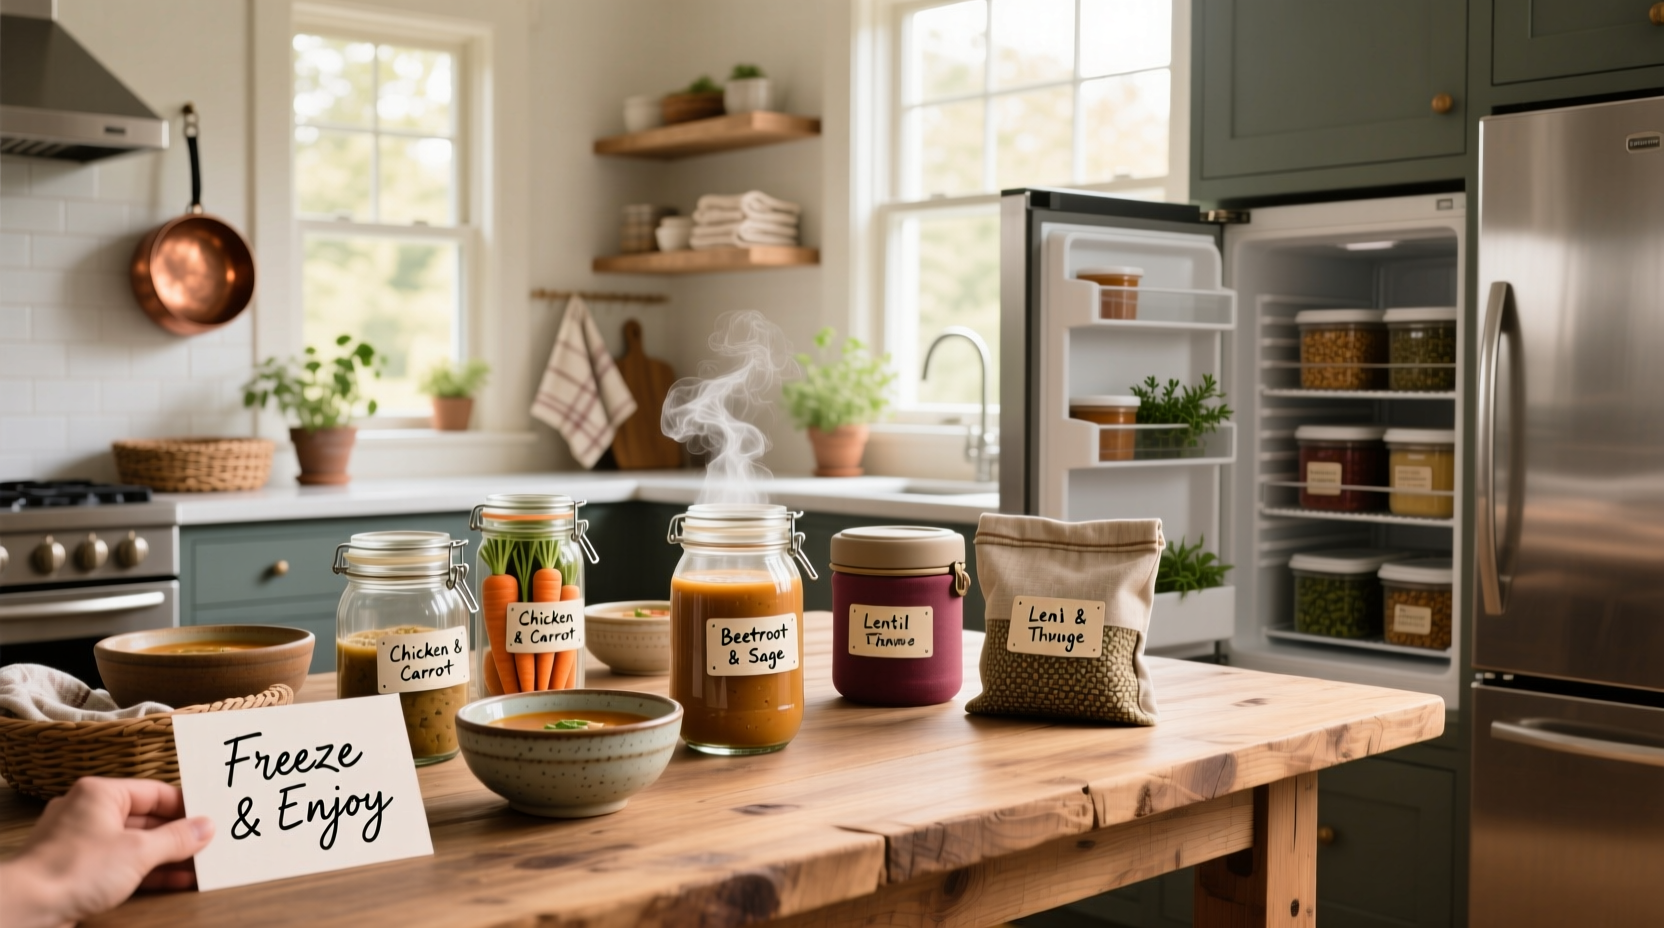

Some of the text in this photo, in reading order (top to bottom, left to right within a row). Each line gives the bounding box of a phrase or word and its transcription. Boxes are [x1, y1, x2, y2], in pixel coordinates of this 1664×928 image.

[518, 609, 574, 627] Chicken
[863, 612, 909, 630] Lentil
[1074, 608, 1087, 625] &
[513, 627, 576, 645] & Carrot
[721, 622, 789, 647] Beetroot
[389, 638, 463, 663] Chicken &
[728, 647, 785, 670] & Sage
[400, 659, 455, 682] Carrot
[223, 731, 364, 788] Freeze
[230, 782, 394, 851] & Enjoy
